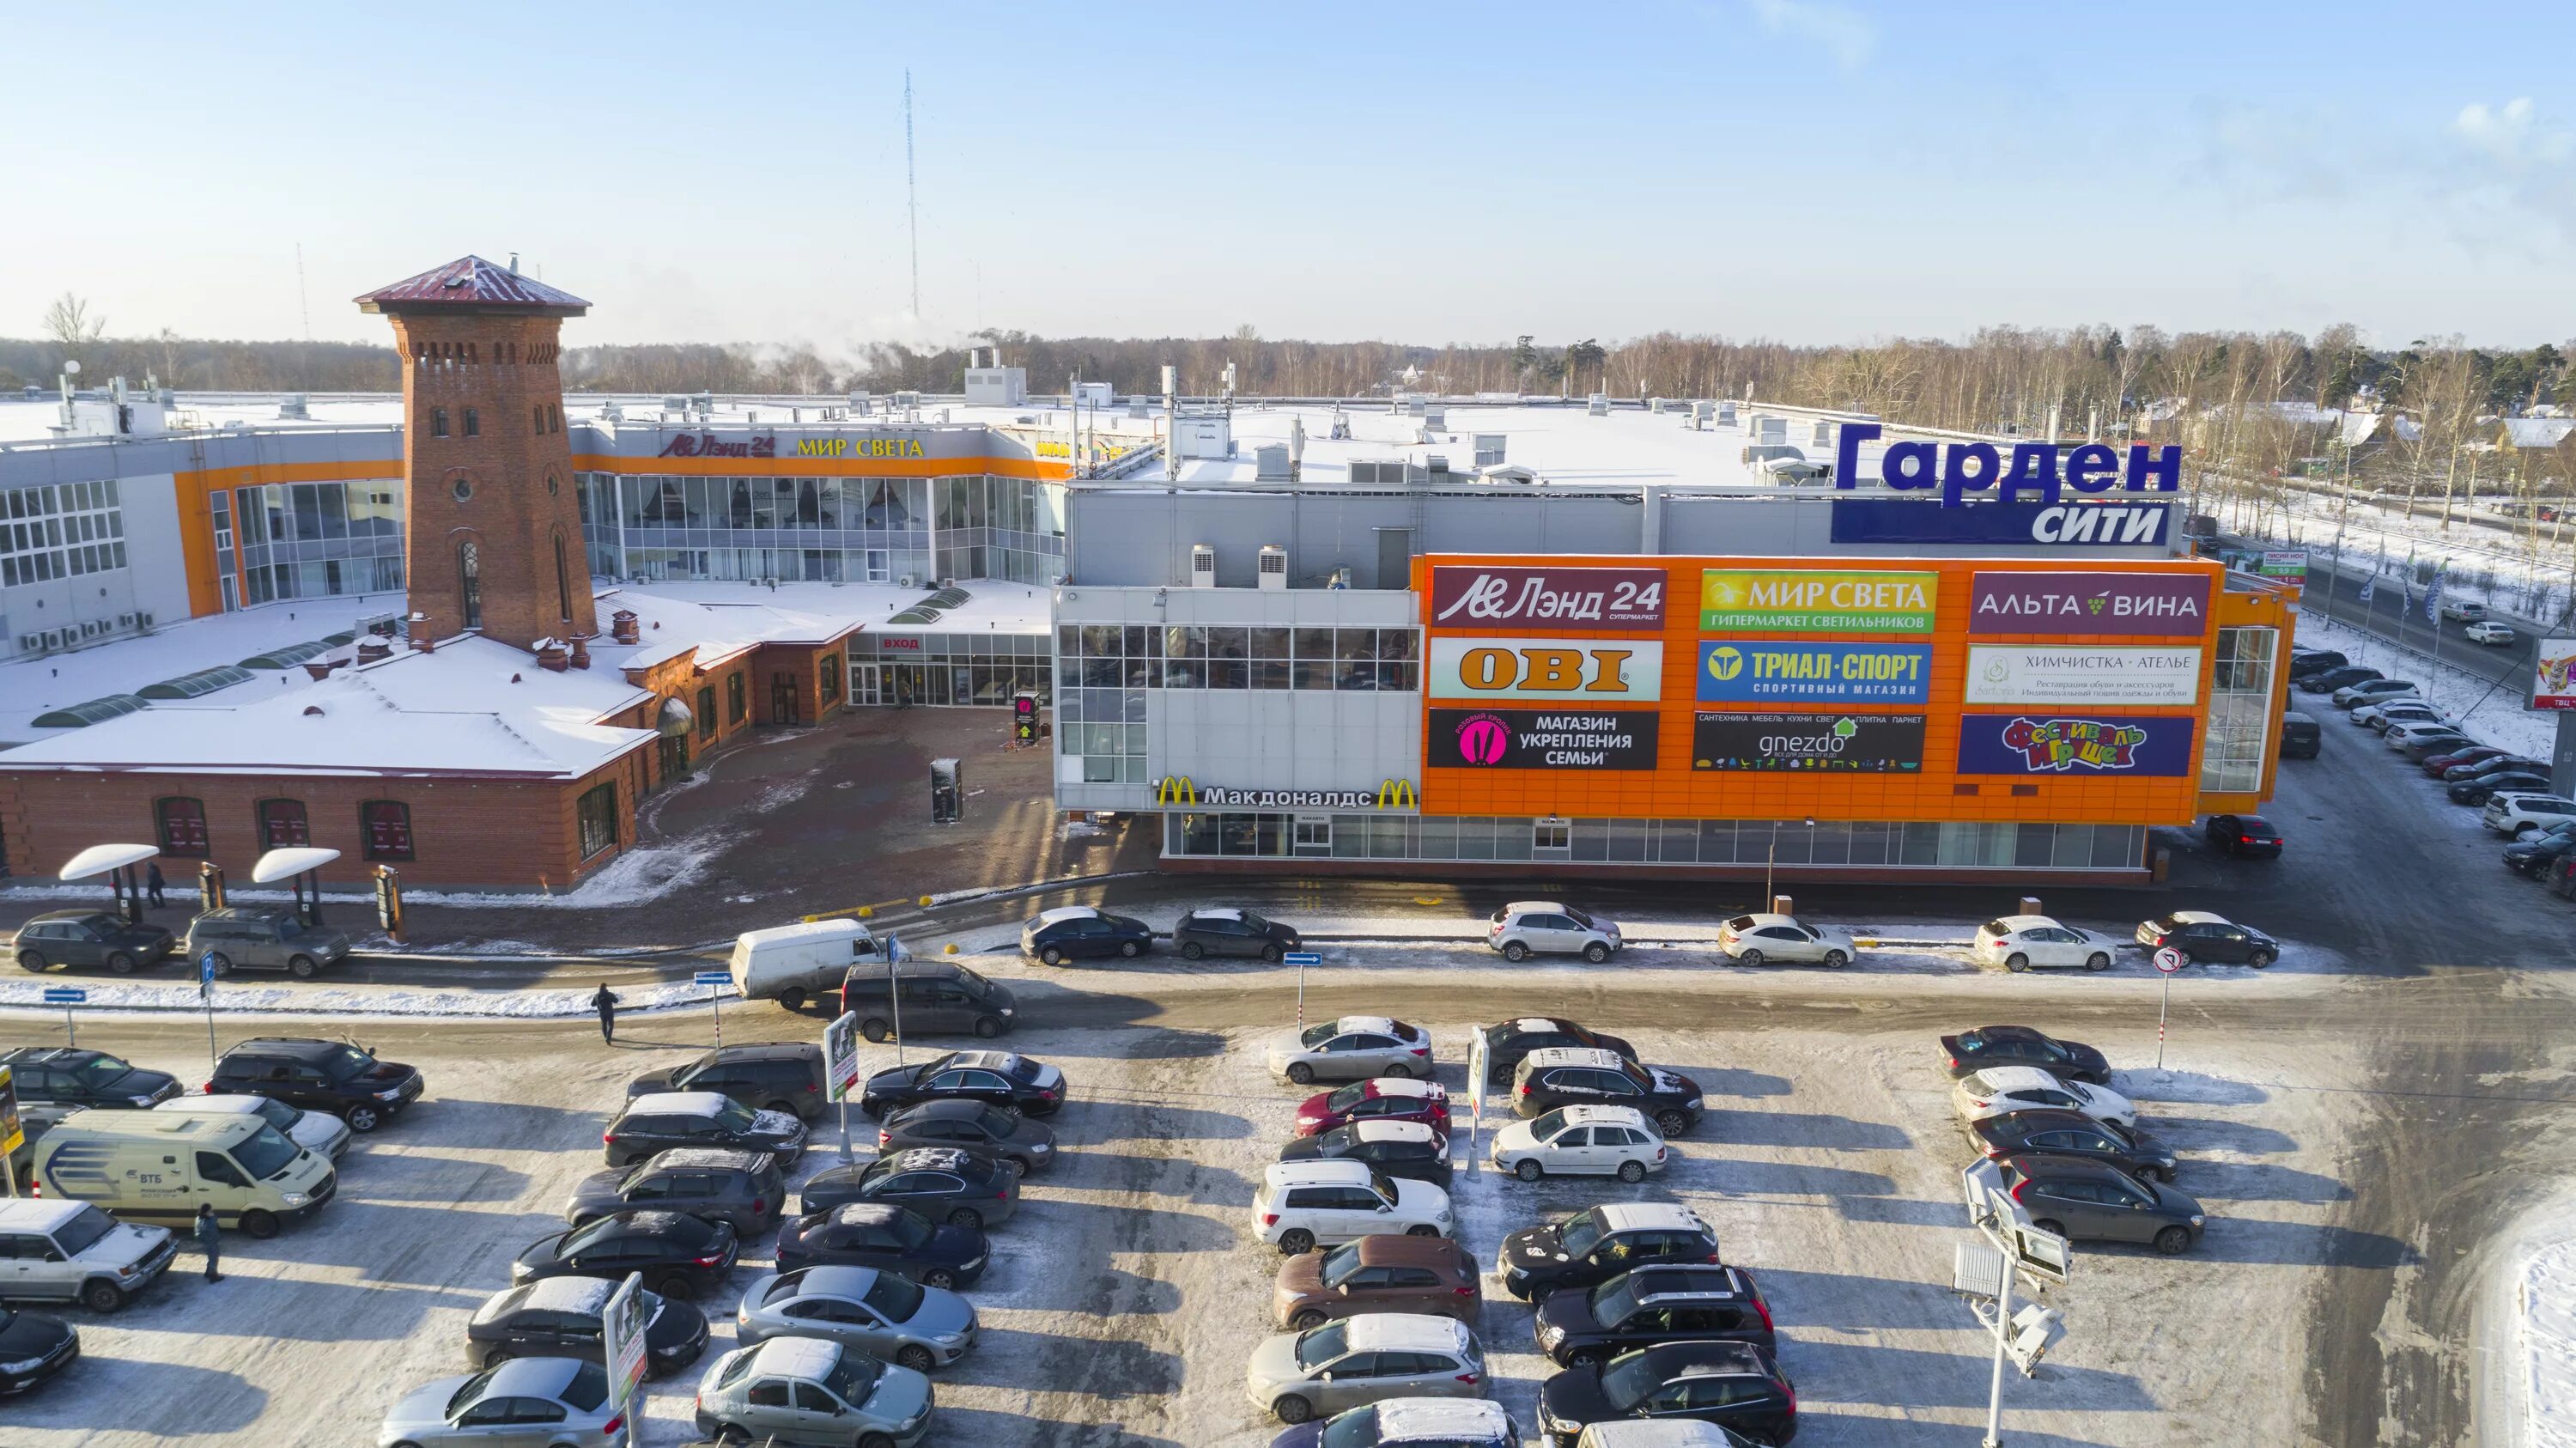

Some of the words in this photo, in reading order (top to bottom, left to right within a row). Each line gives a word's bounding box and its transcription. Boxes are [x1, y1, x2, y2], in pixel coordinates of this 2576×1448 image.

[751, 437, 775, 451] 24
[798, 439, 847, 457] МИР
[856, 439, 925, 457] СВЕТА
[1836, 423, 2182, 508] Гарден
[2032, 507, 2163, 543] СИТИ
[1610, 581, 1662, 611] 24
[1748, 581, 1825, 607] МИР
[1830, 582, 1927, 608] СВЕТА
[1978, 593, 2081, 615] АЛЬТА
[2113, 595, 2198, 617] ВИНА
[1711, 615, 1809, 628] ГИПЕРМАРКЕТ
[1812, 616, 1924, 629] СВЕТИЛЬНИКОВ
[884, 638, 919, 650] ВХОД
[1460, 648, 1632, 692] OBI
[2025, 655, 2123, 669] ХИМЧИСТКА
[2137, 656, 2191, 669] АТЕЛЬЕ
[1753, 682, 1845, 695] СПОРТИВНЫЙ
[1854, 684, 1917, 695] МАГАЗИН
[2021, 689, 2091, 697] Индивидуальный
[2163, 689, 2187, 697] обуви
[2036, 680, 2087, 689] Реставрация
[2090, 681, 2114, 690] обуви
[1455, 713, 1486, 734] РОЗОВЫЙ
[1488, 714, 1512, 735] КРОЛИК
[1535, 716, 1616, 731] МАГАЗИН
[1520, 733, 1631, 749] УКРЕПЛЕНИЯ
[1759, 732, 1844, 757] gnezdo
[1546, 751, 1604, 765] СЕМЬИ
[1202, 787, 1373, 808] Макдоналдс
[140, 1174, 162, 1183] ВТБ
